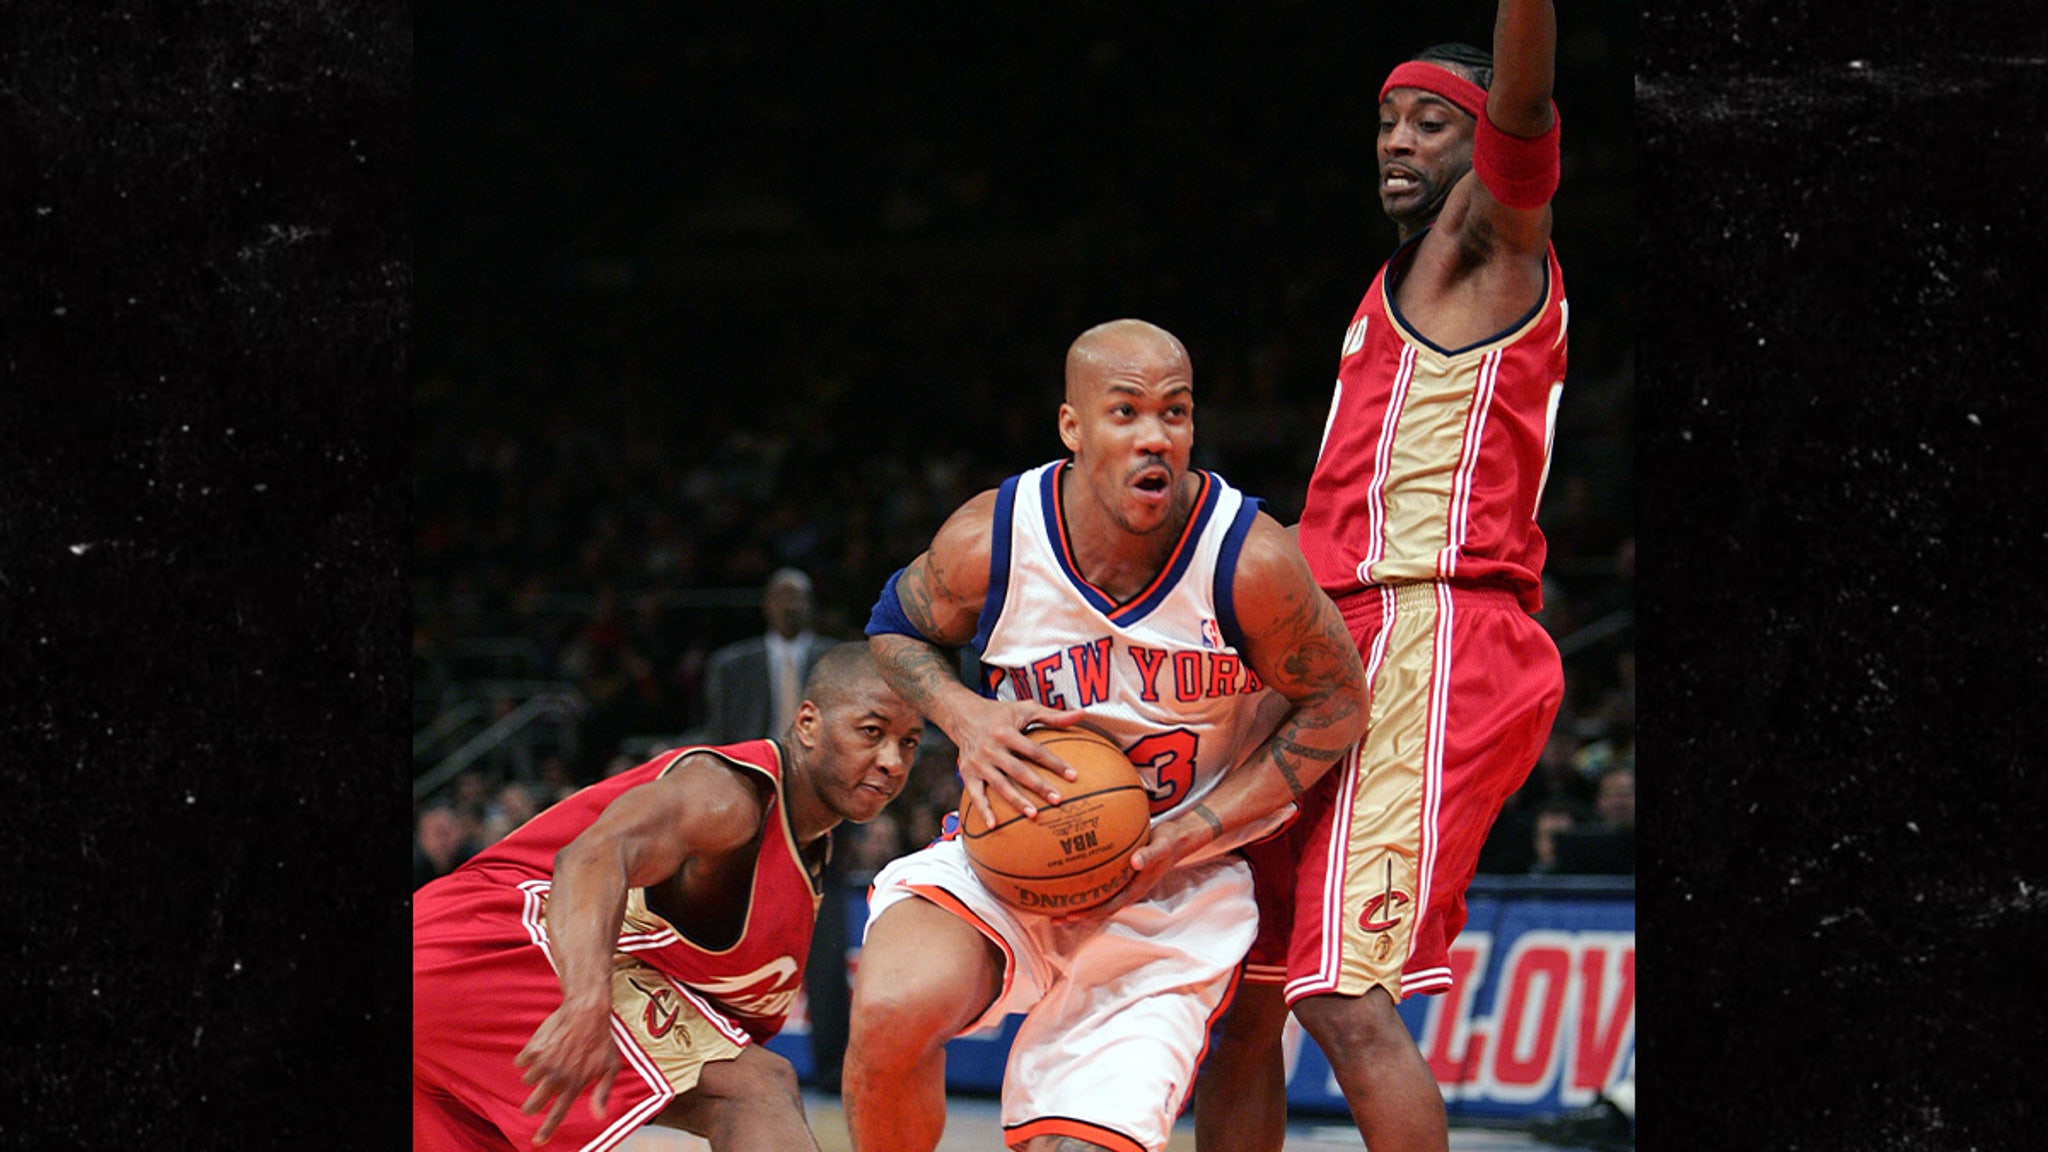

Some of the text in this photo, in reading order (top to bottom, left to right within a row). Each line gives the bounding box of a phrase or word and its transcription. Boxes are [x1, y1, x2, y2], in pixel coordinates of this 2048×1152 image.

[1009, 636, 1113, 711] NEW
[1060, 830, 1097, 854] NBA
[1019, 868, 1129, 908] PALDING
